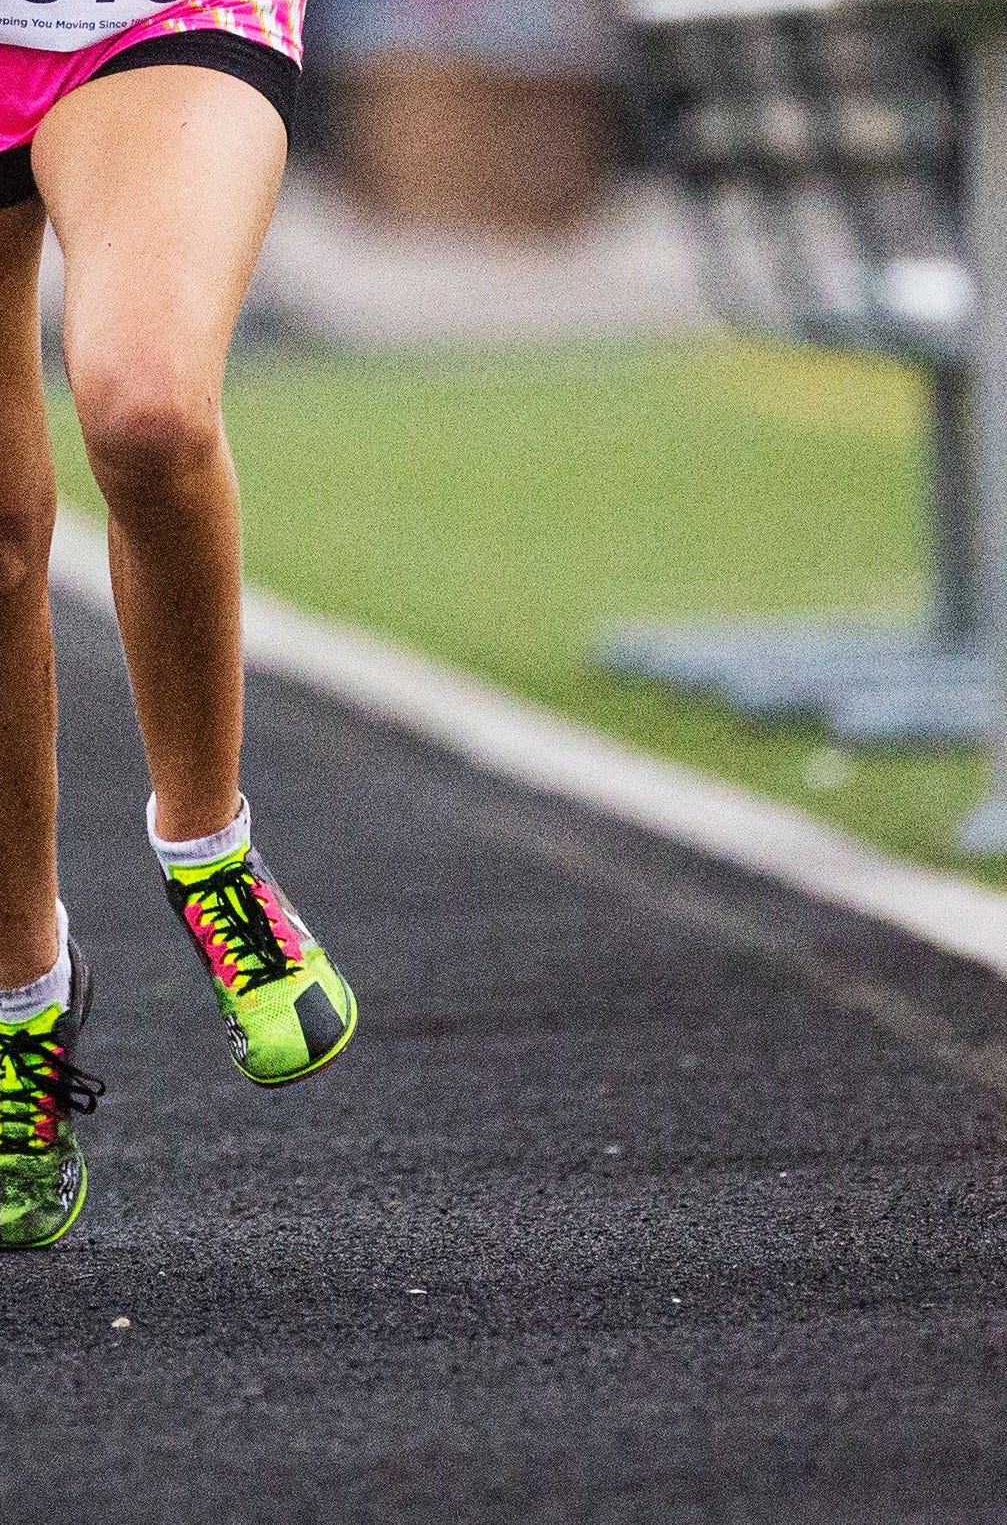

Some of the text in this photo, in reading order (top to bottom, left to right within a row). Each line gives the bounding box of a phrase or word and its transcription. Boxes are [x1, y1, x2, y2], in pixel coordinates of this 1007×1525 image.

[31, 18, 53, 28] You
[55, 20, 96, 30] Moving
[98, 19, 128, 29] Since
